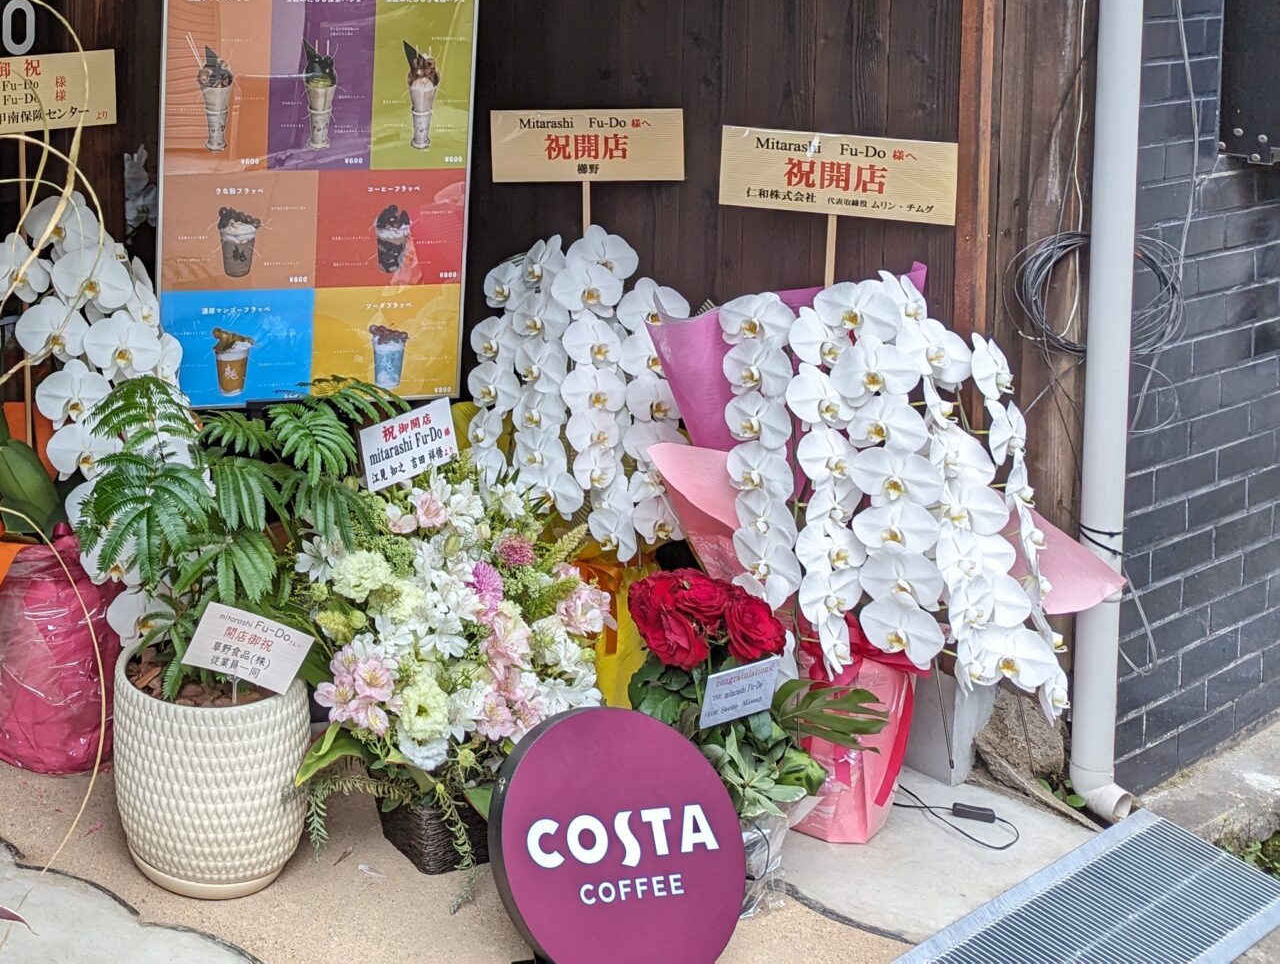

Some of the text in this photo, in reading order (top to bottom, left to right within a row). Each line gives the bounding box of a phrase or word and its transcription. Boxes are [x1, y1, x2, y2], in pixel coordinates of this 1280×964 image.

[2, 79, 39, 92] Fu-Do
[55, 75, 67, 88] 様
[55, 89, 67, 102] 様
[95, 111, 108, 120] より
[519, 116, 652, 129] Mitarashi Fu-Do 様へ
[544, 133, 629, 160] 祝開店
[755, 136, 917, 161] Mitarashi Fu-Do 様へ
[784, 157, 888, 195] 祝開店
[746, 186, 817, 204] 仁和株式会社
[827, 196, 868, 208] 代表取締役
[369, 436, 413, 466] mitarashi
[415, 426, 443, 448] Fu-Do
[410, 454, 426, 469] 吉田
[219, 613, 255, 628] mitarashi
[255, 620, 291, 642] Fu-Do
[223, 626, 274, 653] 開店御祝
[210, 655, 261, 679] 従業員一同
[211, 640, 271, 670] 草野食品(株)
[527, 804, 720, 868] COSTA
[580, 874, 685, 905] COFFEE
